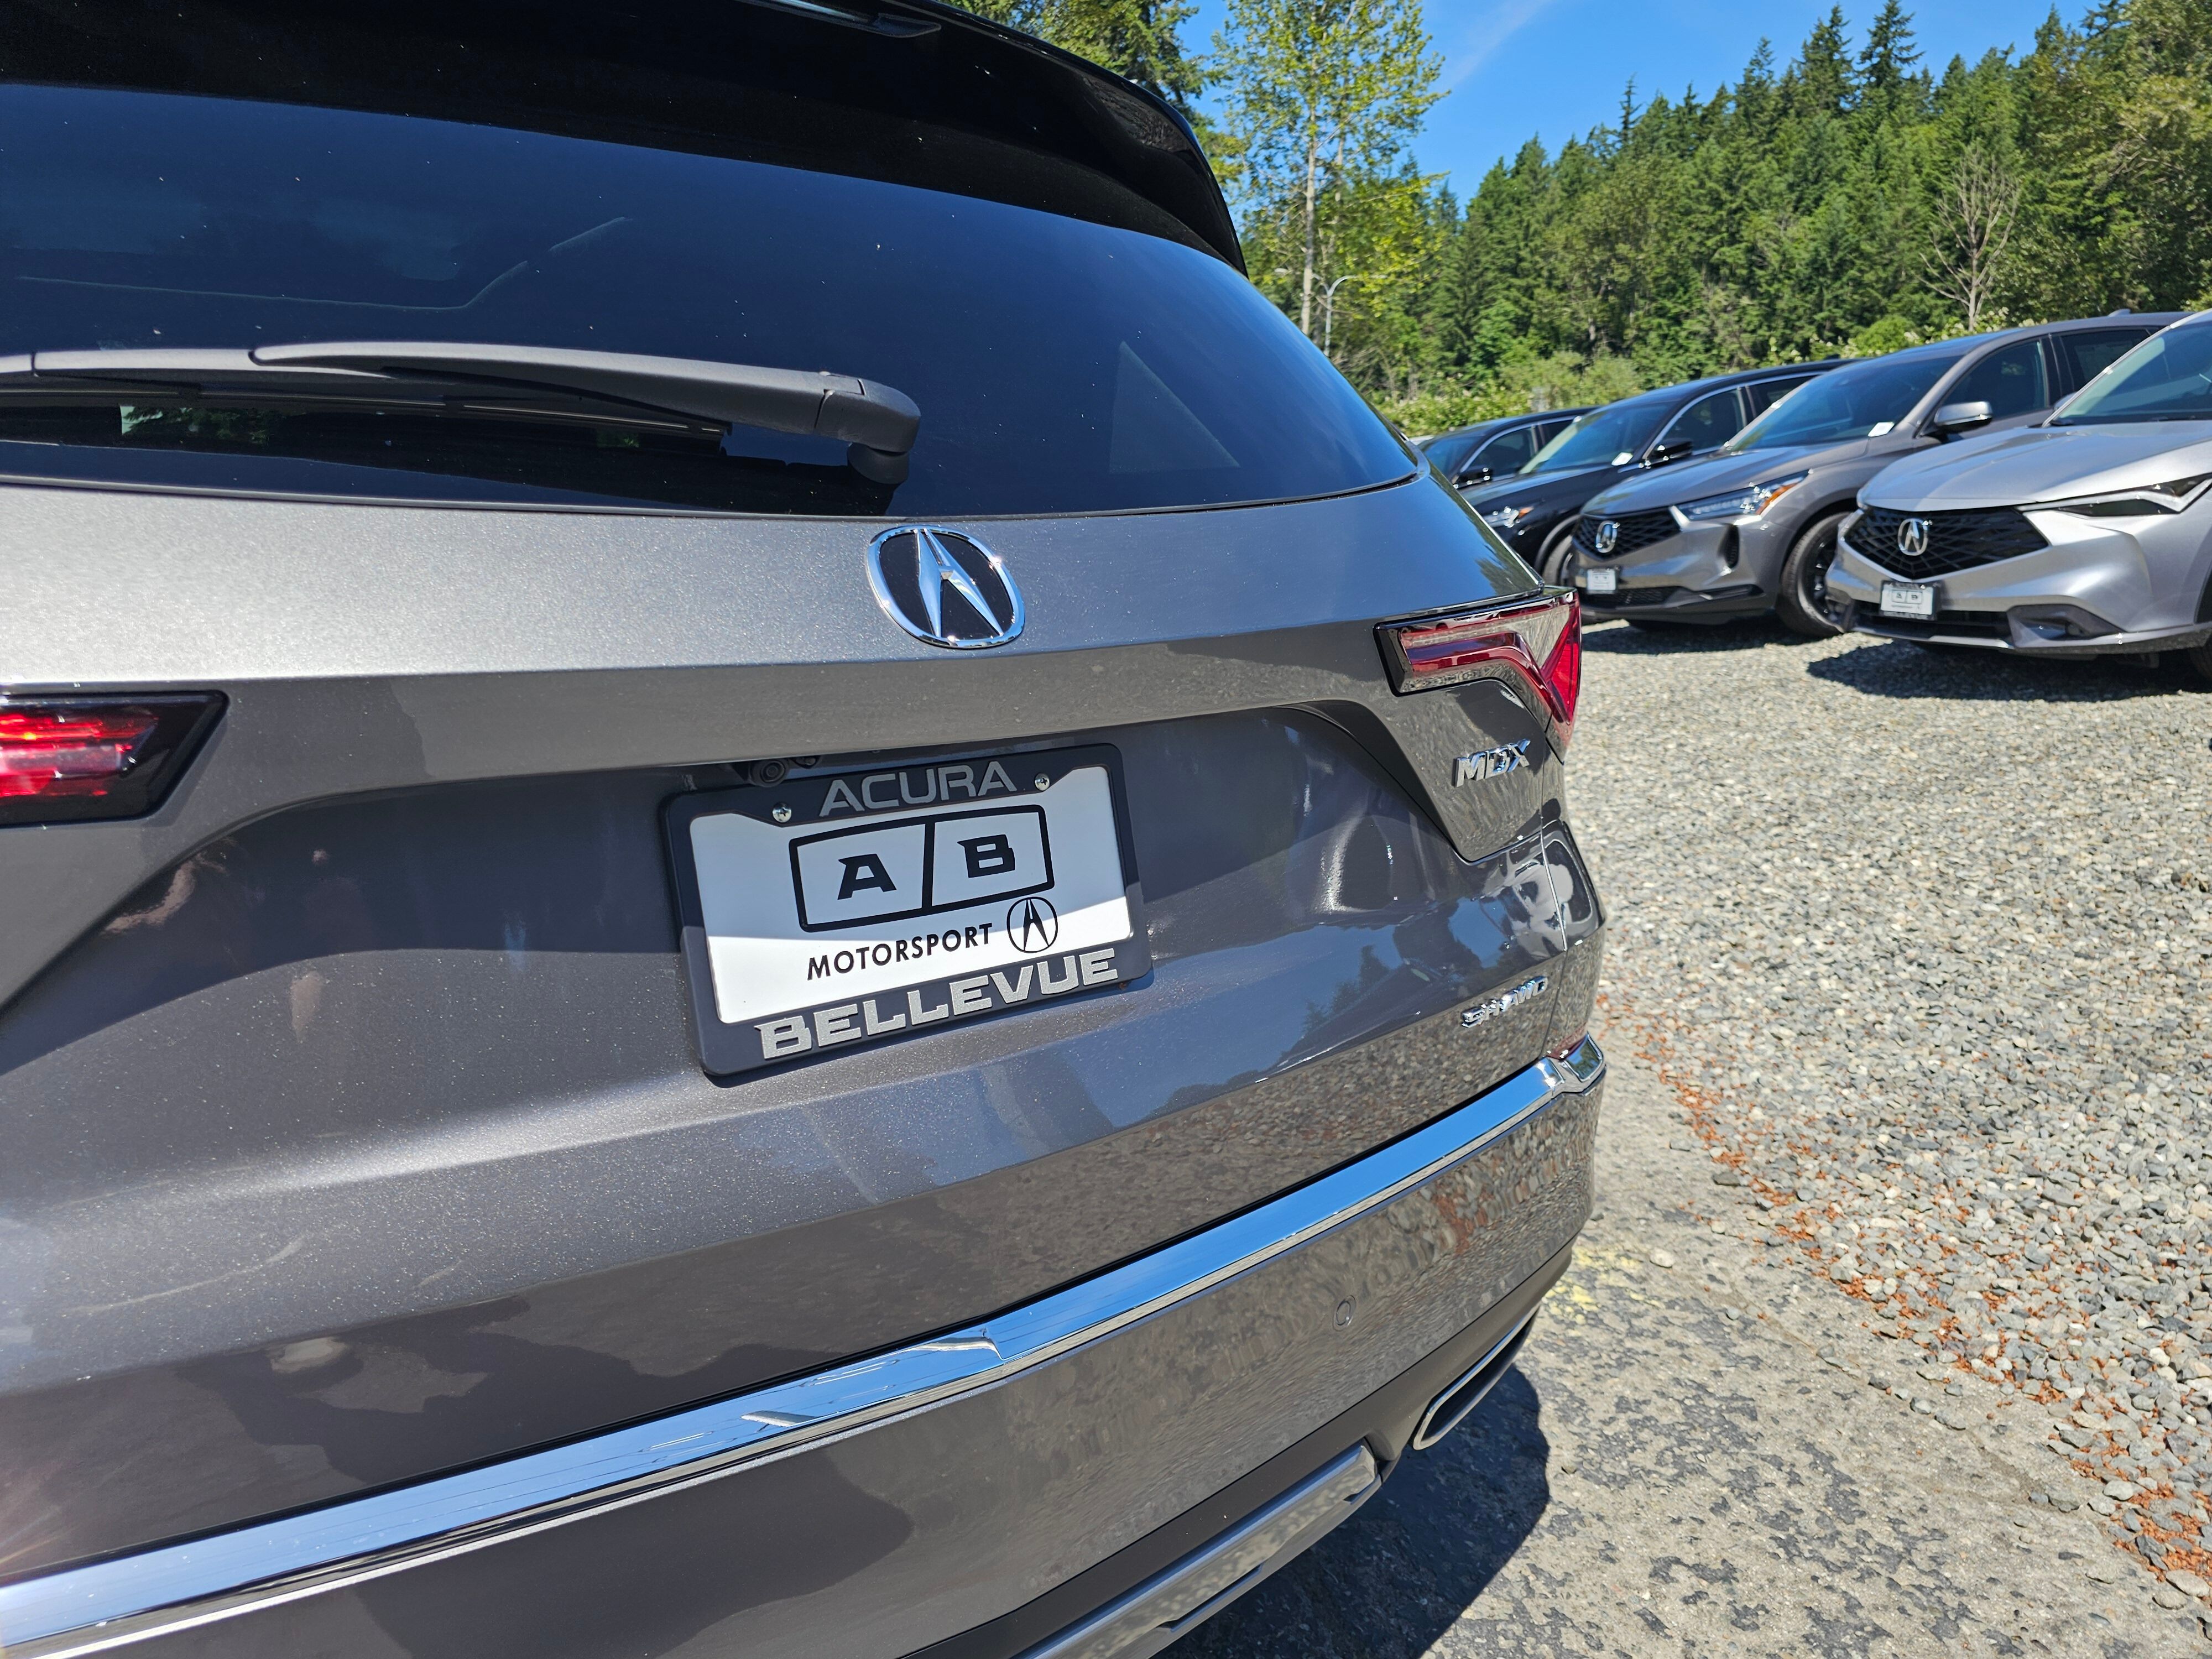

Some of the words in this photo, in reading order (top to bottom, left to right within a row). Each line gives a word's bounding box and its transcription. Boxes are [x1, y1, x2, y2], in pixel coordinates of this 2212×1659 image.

[820, 761, 1017, 817] ACURA
[1453, 739, 1531, 787] MDX
[837, 853, 896, 900] A
[957, 834, 1015, 878] B
[807, 922, 993, 980] MOTORSPORT
[754, 948, 1118, 1060] BELLEVUE
